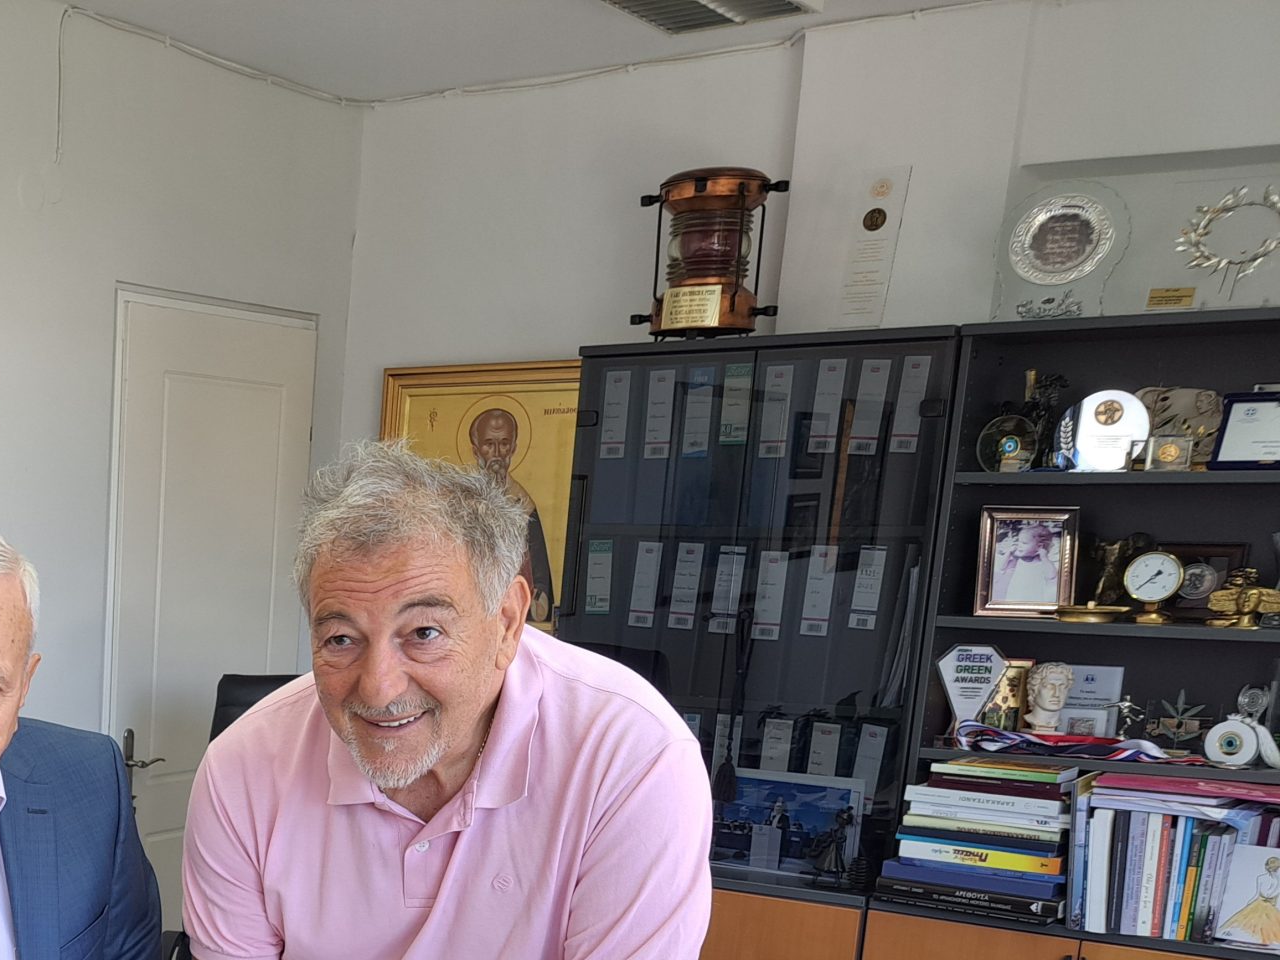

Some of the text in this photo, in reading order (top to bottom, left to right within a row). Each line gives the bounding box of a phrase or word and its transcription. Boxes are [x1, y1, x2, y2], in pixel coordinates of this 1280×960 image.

[956, 652, 993, 664] GREEK
[955, 664, 992, 675] GREEN
[953, 675, 991, 685] AWARDS
[955, 890, 989, 900] ΑΡΕΘΟΥΣΑ
